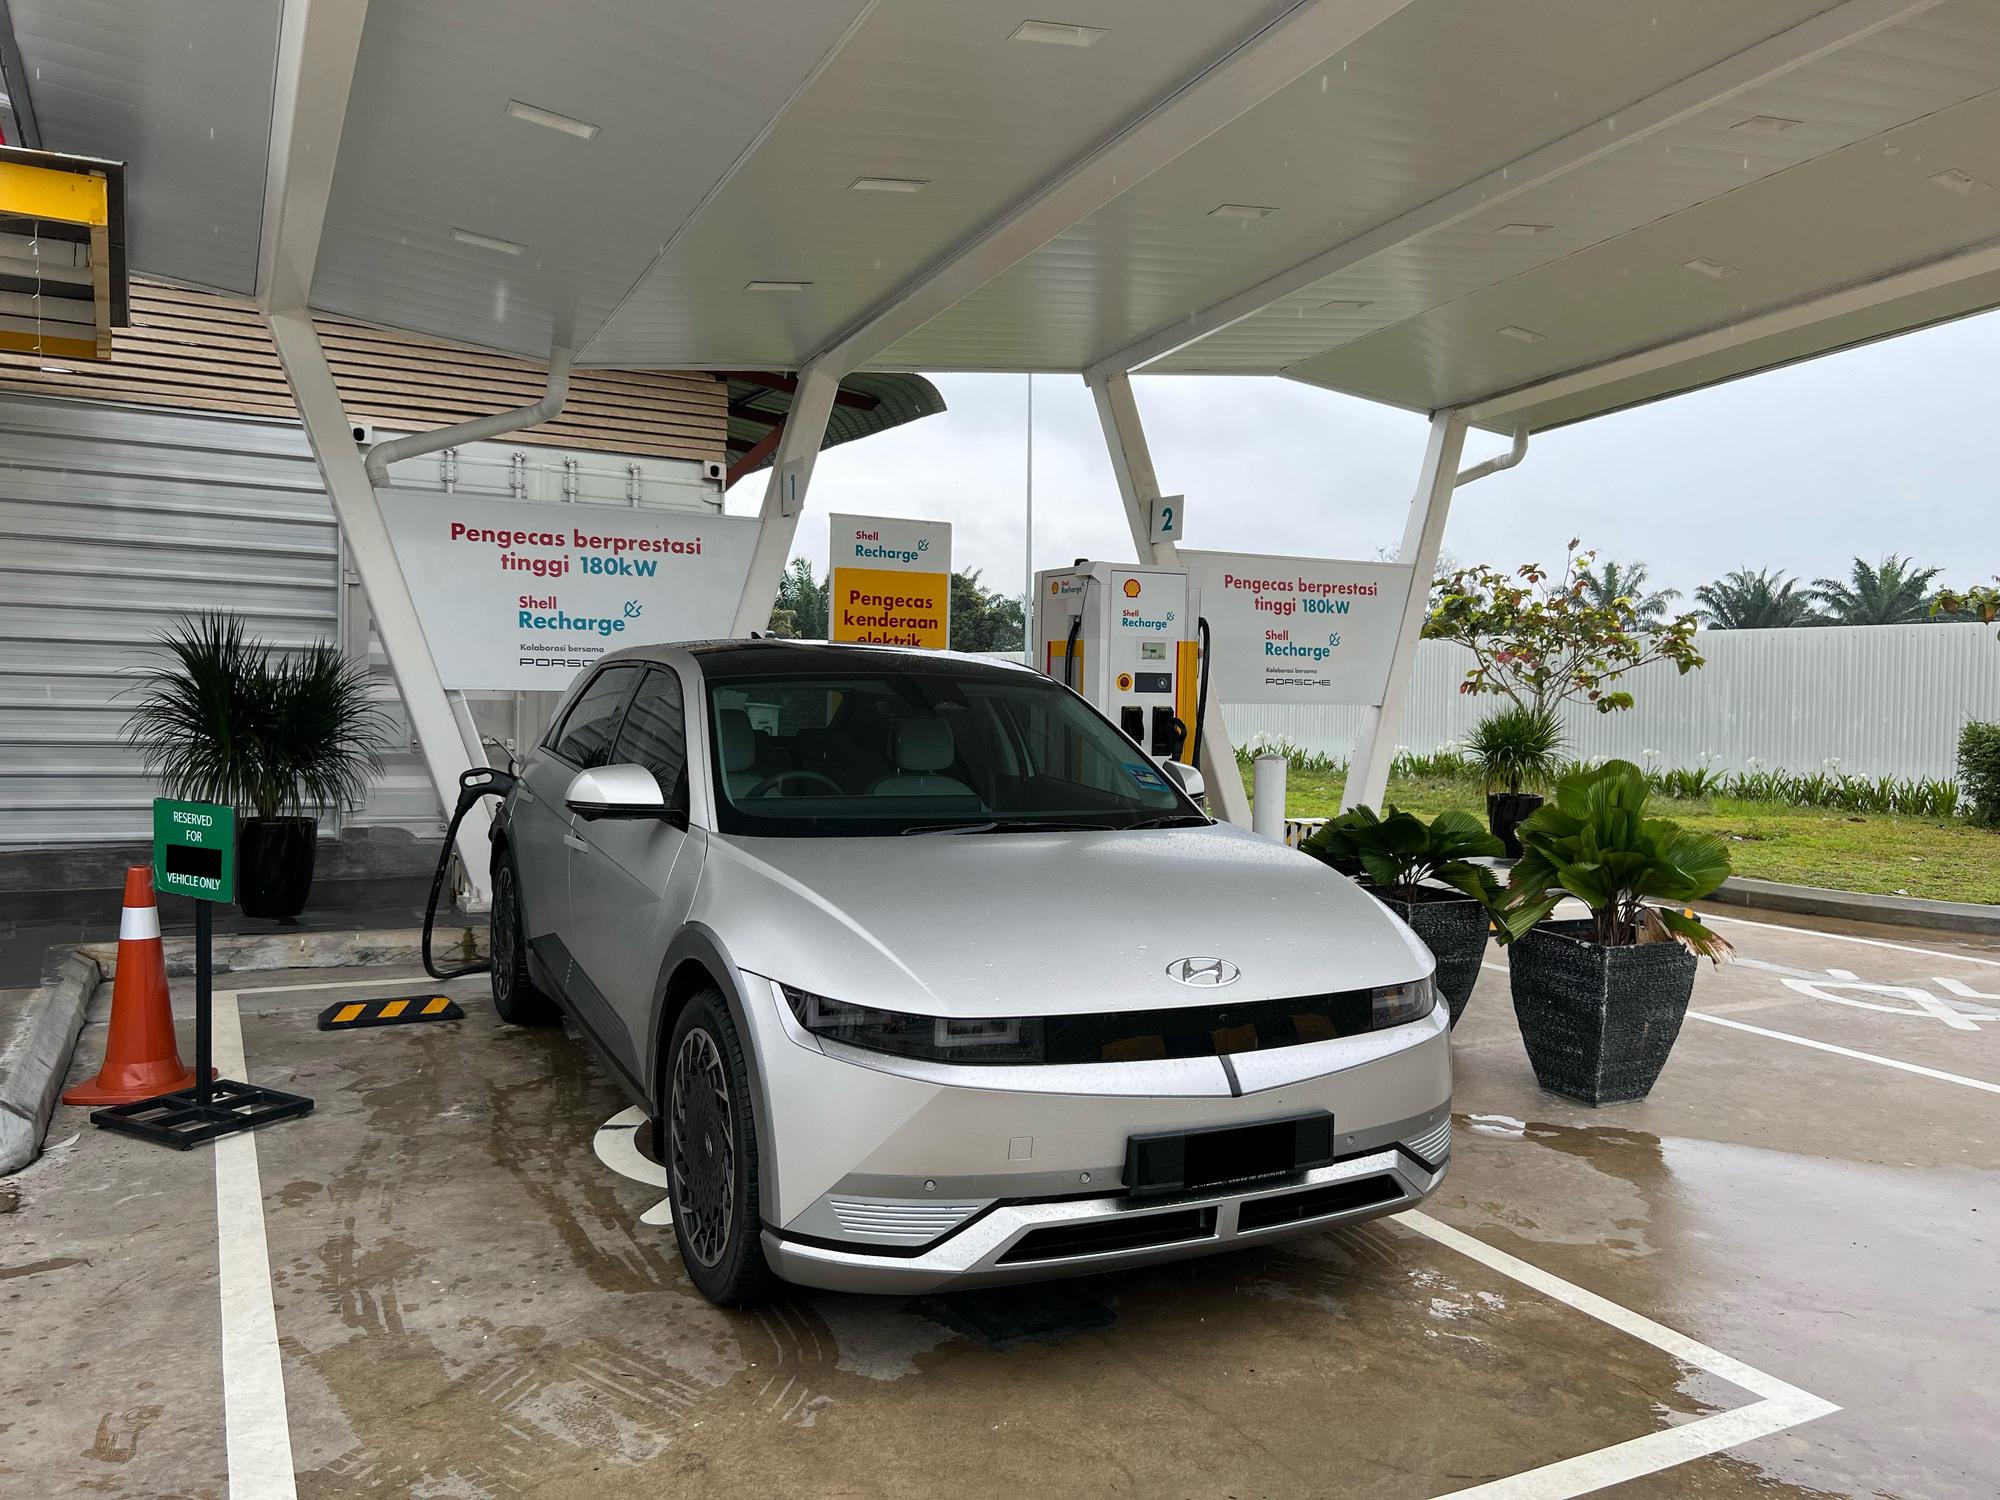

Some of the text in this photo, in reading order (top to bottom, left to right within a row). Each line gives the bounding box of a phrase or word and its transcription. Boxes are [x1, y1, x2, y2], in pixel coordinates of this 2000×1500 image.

[1161, 507, 1173, 532] 2
[451, 522, 702, 556] Pengecas berprestasi
[856, 531, 879, 541] Shell
[855, 545, 918, 562] Recharge
[501, 552, 658, 577] tinggi 180kW
[1224, 574, 1378, 597] Pengecas berprestasi
[519, 595, 557, 610] Shell
[850, 590, 933, 611] Pengecas
[1254, 596, 1350, 615] tinggi 180kW
[518, 611, 625, 636] Recharge
[844, 610, 938, 630] kenderaan
[1122, 618, 1167, 631] Recharge
[1265, 630, 1289, 641] Shell
[520, 644, 605, 653] Kolaborasi bersama
[1265, 642, 1330, 661] Recharge
[520, 658, 595, 668] PORSC
[1265, 678, 1331, 687] PORSCHE
[173, 811, 213, 826] RESERVED
[186, 830, 203, 842] FOR
[167, 872, 221, 890] VEHICLE ONLY
